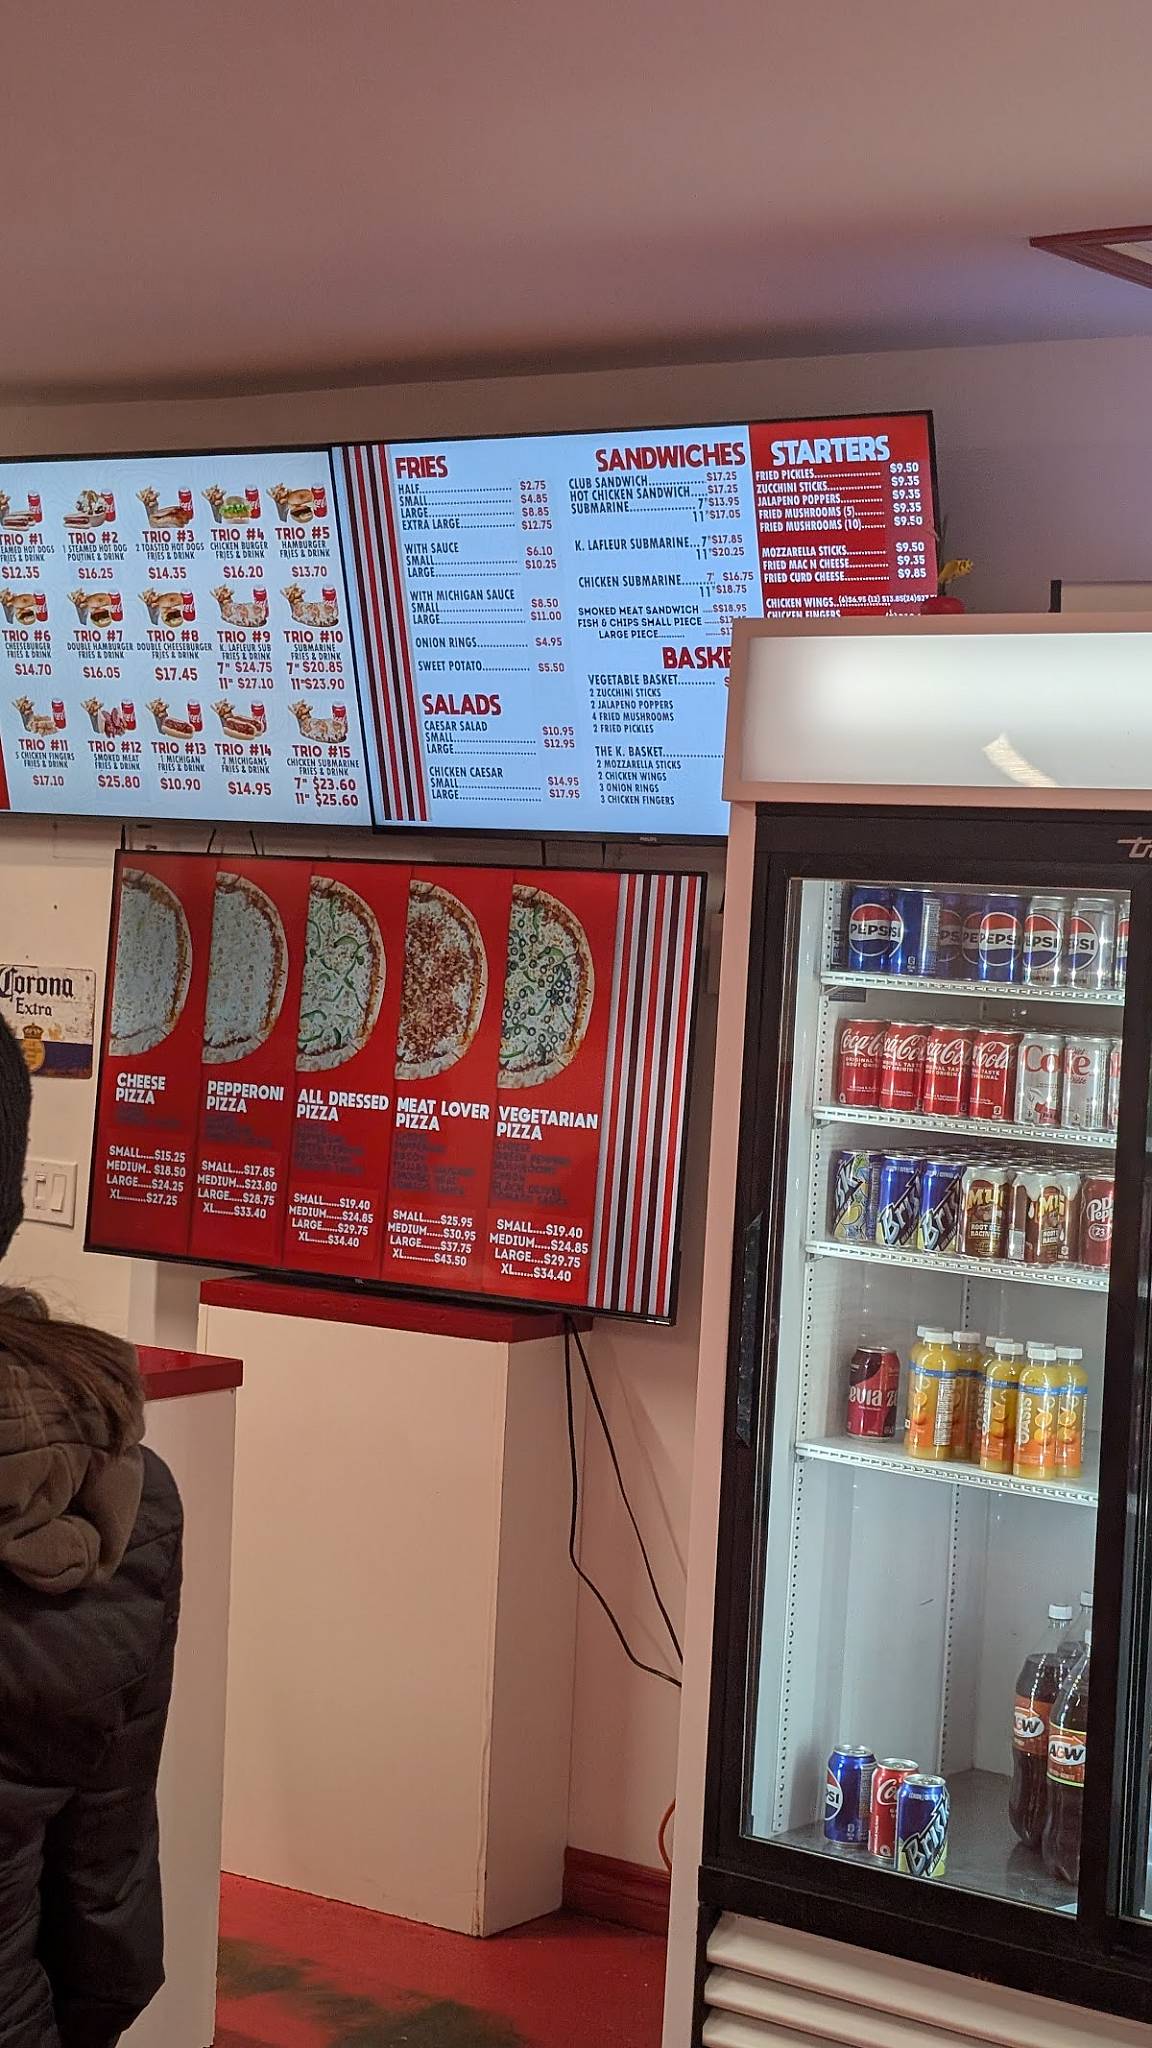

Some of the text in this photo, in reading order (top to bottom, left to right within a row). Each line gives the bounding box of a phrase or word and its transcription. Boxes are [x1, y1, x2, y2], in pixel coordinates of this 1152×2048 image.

[595, 442, 746, 472] SANDWICHES
[771, 436, 890, 466] STARTERS
[395, 456, 448, 479] FRIES
[756, 462, 919, 480] FRIED $9.50
[520, 480, 546, 491] $2.75
[568, 472, 737, 490] CLUB $17.25
[757, 476, 920, 494] ZUCCHINI $9.35
[520, 494, 548, 504] $4.85
[570, 485, 738, 502] HOT CHICKEN $17.25
[758, 489, 920, 507] JALAPENO $9.35
[522, 507, 549, 517] $8.85
[759, 502, 921, 519] FRIED MUSHROOMS $9.35
[402, 520, 552, 531] EXTRA $12.75
[29, 533, 43, 546] #1
[68, 532, 118, 545] TRIO #2
[142, 530, 195, 543] TRIO #3
[211, 528, 264, 541] TRIO #4
[275, 527, 330, 539] TRIO #5
[210, 542, 268, 551] CHICKEN BURGER
[282, 540, 326, 549] HAMBURGER
[404, 542, 459, 555] WITH SAUCE
[527, 546, 553, 556] $6.10
[588, 538, 627, 551] LAFLEUR
[762, 542, 925, 558] MOZZARELLA $9.50
[526, 560, 557, 570] $10.25
[763, 555, 926, 570] FRIED MAC $9.35
[2, 566, 40, 579] $12.35
[78, 568, 113, 580] $16.25
[148, 567, 187, 579] $14.35
[223, 566, 263, 579] $16.20
[292, 566, 327, 578] $13.70
[790, 568, 927, 582] CURD $9.85
[579, 572, 754, 588] CHICKEN $16.75
[410, 589, 515, 601] WITH MICHIGAN SAUCE
[531, 598, 559, 608] $8.50
[766, 598, 800, 609] CHICKEN
[530, 611, 562, 621] $11.00
[578, 606, 643, 616] SMOKED MEAT
[2, 630, 51, 642] TRIO #6
[73, 630, 123, 642] TRIO #7
[147, 630, 199, 642] TRIO #8
[217, 631, 270, 643] TRIO #9
[283, 631, 343, 643] TRIO #10
[415, 637, 562, 648] ONION $4.95
[15, 664, 52, 676] $14.70
[235, 662, 273, 674] $24.75
[303, 662, 343, 674] $20.85
[418, 660, 565, 672] SWEET $5.50
[83, 667, 121, 679] $16.05
[155, 667, 198, 680] $17.45
[588, 674, 639, 685] VEGETABLE
[237, 678, 274, 690] $27.10
[597, 688, 661, 697] ZUCCHINI STICKS
[421, 694, 502, 716] SALADS
[598, 700, 673, 709] JALAPENO POPPERS
[599, 712, 674, 721] FRIED MUSHROOMS
[424, 721, 487, 731] CAESAR SALAD
[542, 726, 574, 736] $10.95
[18, 739, 69, 751] TRIO #11
[88, 740, 142, 753] TRIO #12
[151, 742, 207, 755] TRIO #13
[215, 743, 272, 756] TRIO #14
[544, 739, 575, 749] $12.95
[292, 745, 351, 758] TRIO #15
[595, 746, 612, 757] THE
[429, 766, 503, 778] CHICKEN CAESAR
[33, 775, 64, 787] $17.10
[98, 775, 141, 788] $25.80
[160, 778, 201, 791] $10.90
[313, 777, 356, 790] $23.60
[547, 776, 579, 786] $14.95
[228, 782, 272, 796] $14.95
[549, 789, 580, 799] $17.95
[315, 793, 359, 806] $25.60
[0, 966, 74, 1002] Corona
[16, 997, 52, 1016] Extra
[117, 1073, 166, 1090] CHEESE
[116, 1087, 155, 1105] PIZZA
[207, 1080, 285, 1101] PEPPERONI
[206, 1096, 248, 1113] PIZZA
[298, 1089, 390, 1111] ALL DRESSED
[296, 1103, 339, 1121] PIZZA
[397, 1097, 490, 1120] MEAT LOVER
[396, 1112, 440, 1131] PIZZA
[499, 1105, 598, 1129] VEGETARIAN
[496, 1121, 542, 1141] PIZZA
